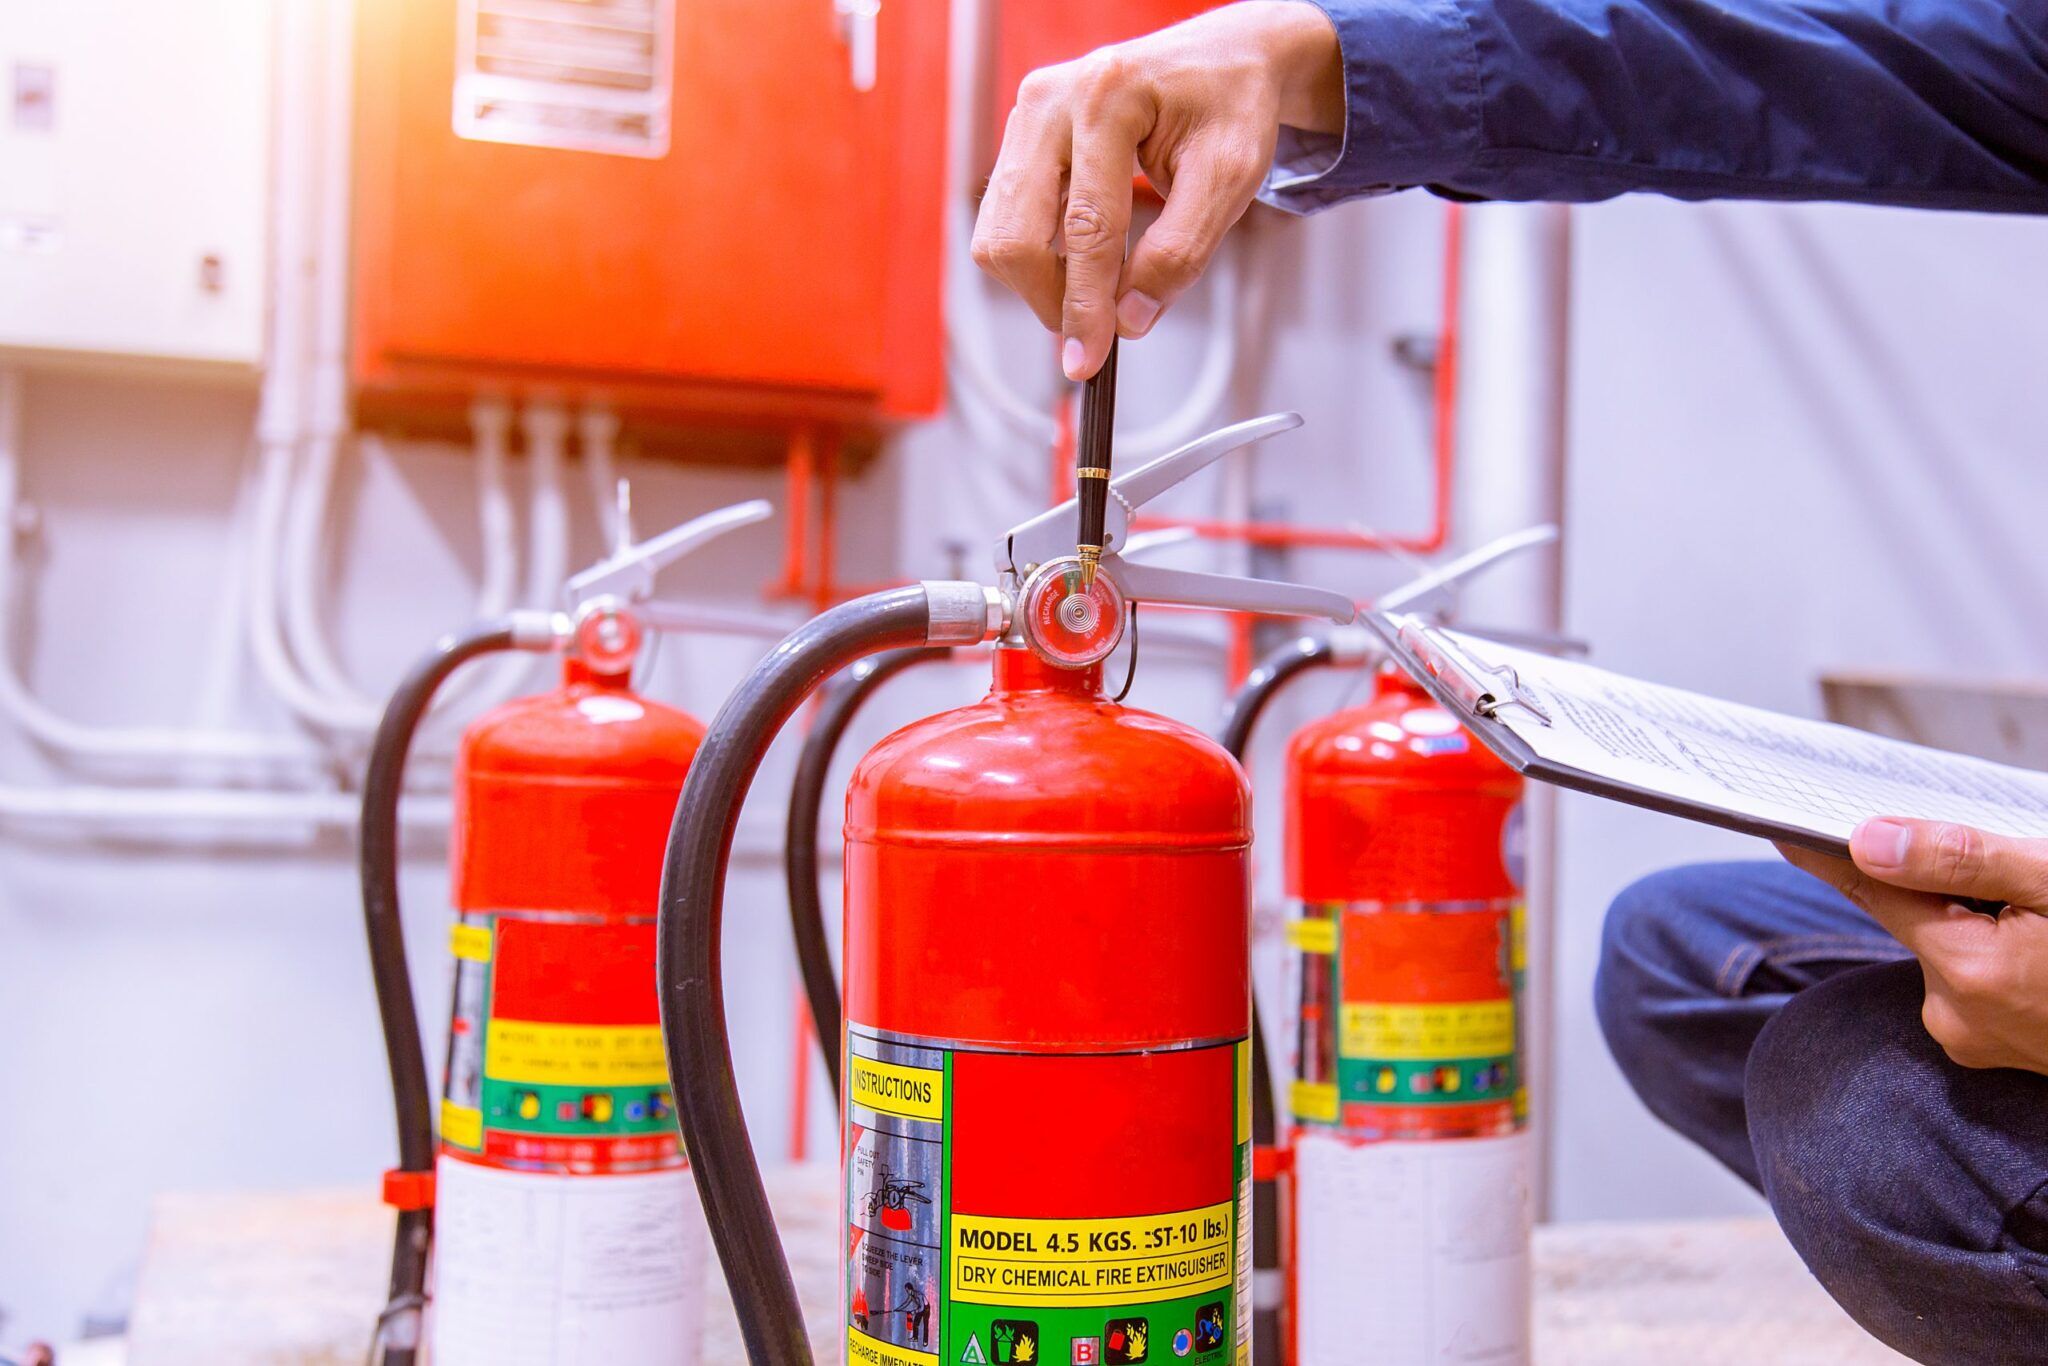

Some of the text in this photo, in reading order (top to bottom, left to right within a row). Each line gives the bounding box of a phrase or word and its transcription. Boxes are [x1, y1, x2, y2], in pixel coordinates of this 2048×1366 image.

[855, 1068, 931, 1103] INSTRUCTIONS
[960, 1228, 1037, 1252] MODEL
[1046, 1233, 1079, 1253] 4.5
[1089, 1231, 1136, 1252] KGS.
[1203, 1213, 1228, 1239] lbs.)
[886, 1250, 898, 1261] THE
[900, 1255, 924, 1267] LEVER
[963, 1251, 1226, 1287] DRY CHEMICAL FIRE EXTINGUISHER
[965, 1346, 980, 1363] A
[1077, 1343, 1092, 1361] B
